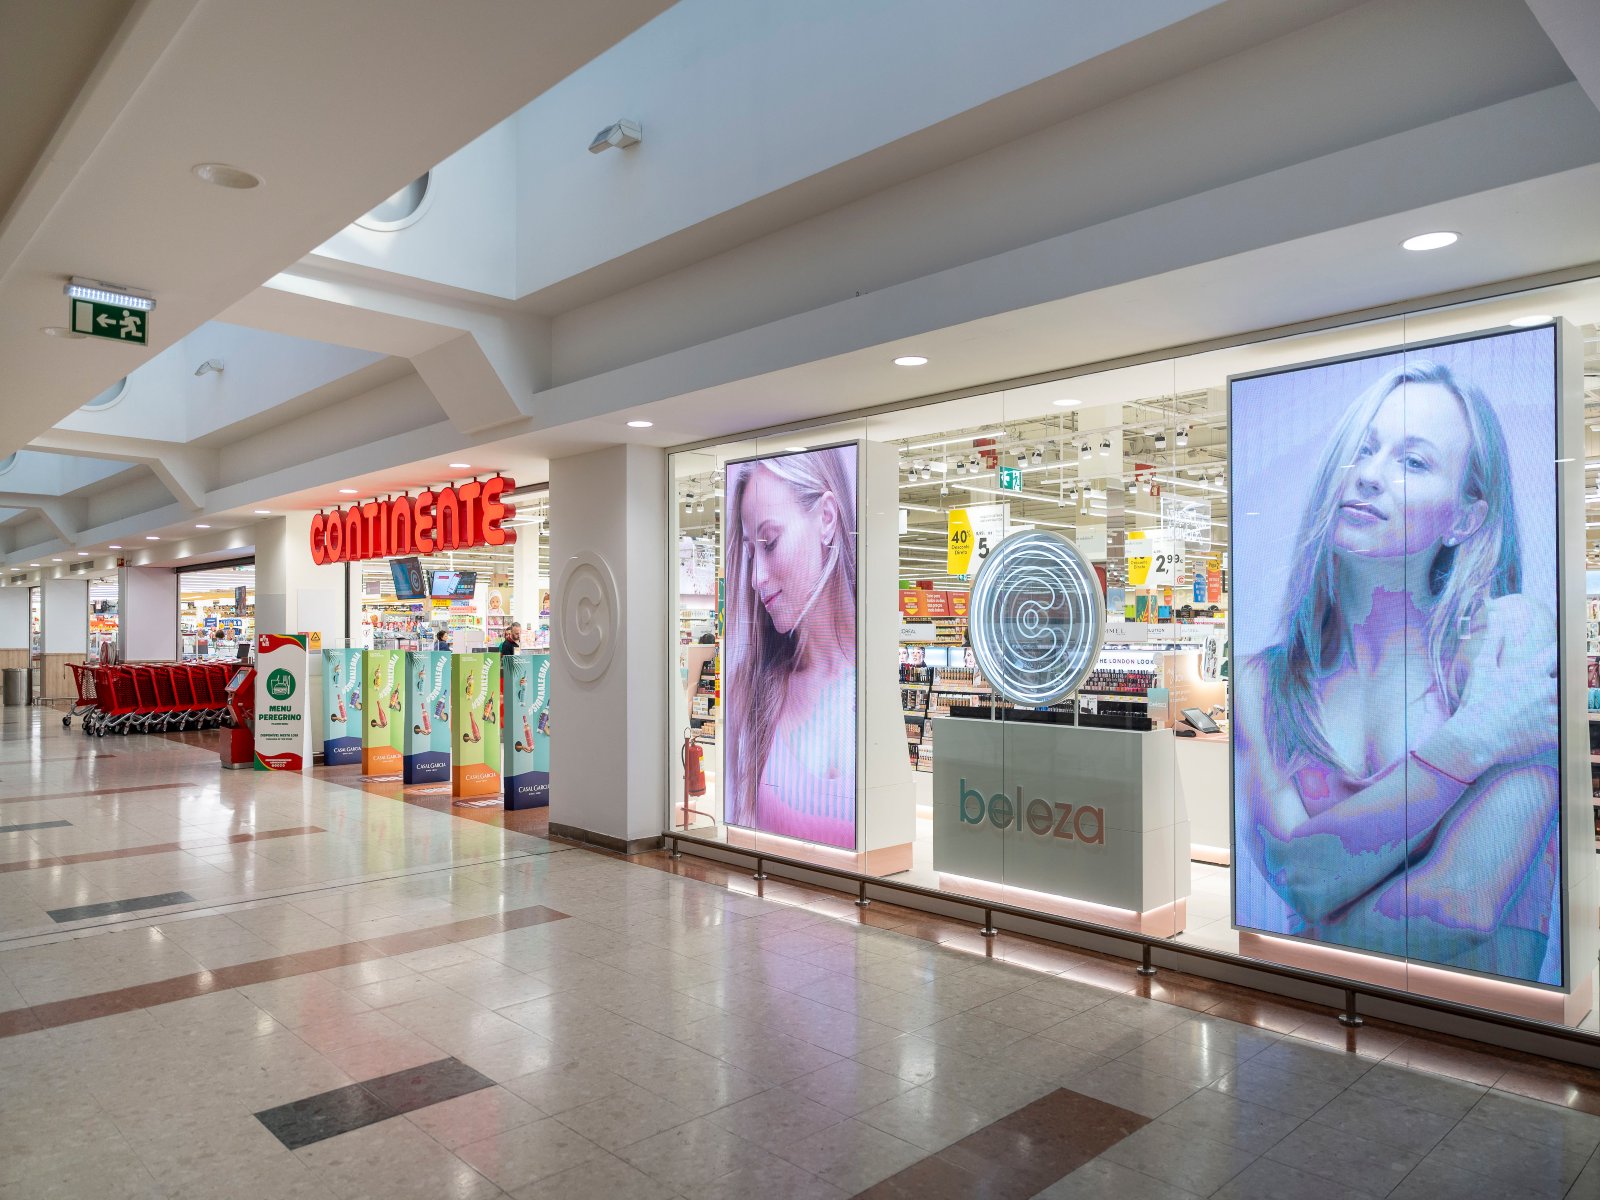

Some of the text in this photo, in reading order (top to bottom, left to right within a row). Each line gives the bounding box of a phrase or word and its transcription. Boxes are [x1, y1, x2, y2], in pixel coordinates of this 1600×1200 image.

[310, 477, 516, 565] CONTINENTE
[258, 713, 302, 721] PEREGRINO
[518, 786, 533, 794] CASAL
[960, 778, 1105, 845] beleza
